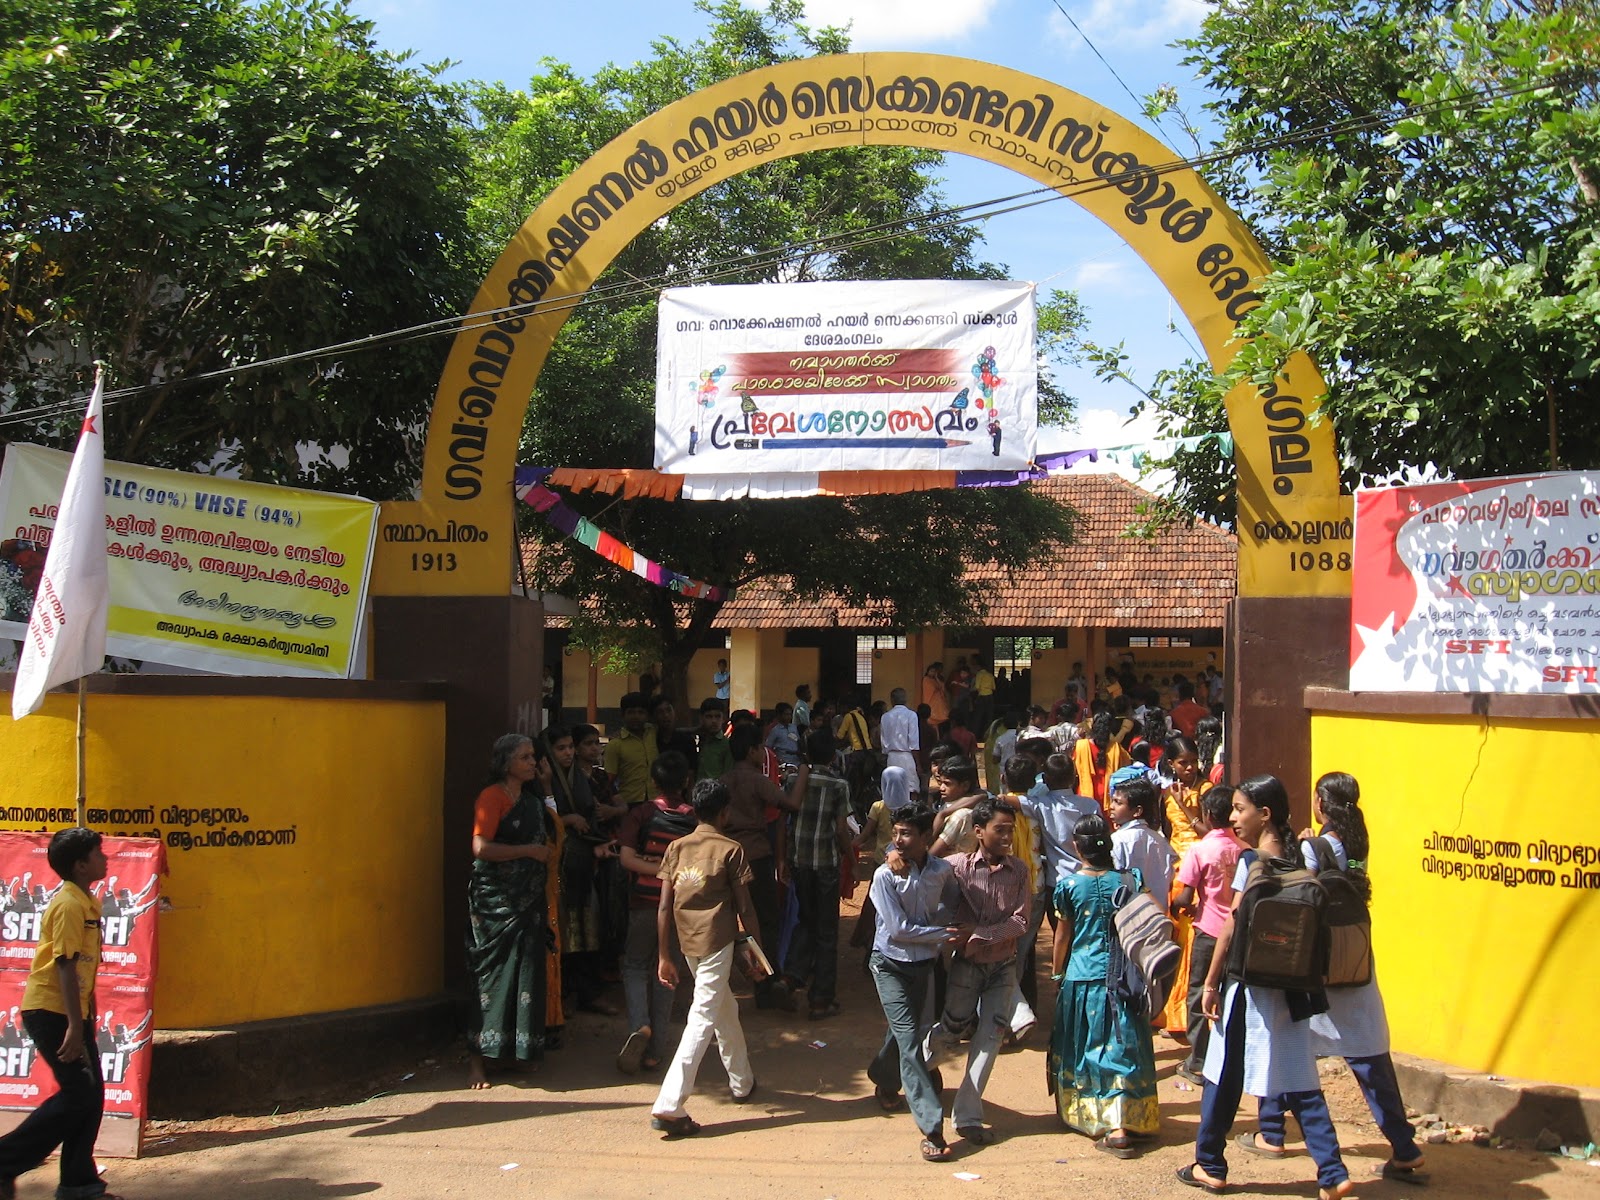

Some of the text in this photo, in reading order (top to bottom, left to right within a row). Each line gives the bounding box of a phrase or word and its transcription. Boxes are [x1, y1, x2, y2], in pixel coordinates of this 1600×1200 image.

[826, 313, 869, 329] ഹയർ
[874, 311, 958, 328] സെക്കണ്ടറി
[962, 310, 1018, 330] സ്കൂൾ
[804, 332, 883, 347] ദേശമംഗലം
[789, 352, 900, 371] നവാഗതർക്ക്
[876, 374, 958, 391] സ്വാഗതം
[712, 405, 979, 450] പ്രവേശനോത്സവം
[194, 491, 247, 519] VHSE
[253, 504, 302, 529] (94%)
[383, 520, 489, 545] സ്ഥാപിതം
[161, 523, 279, 558] ഉന്നതവിജയം
[284, 544, 347, 568] നേടിയ
[411, 552, 458, 572] 1913
[1290, 552, 1351, 572] 1088
[1445, 640, 1511, 655] SFI
[1541, 665, 1599, 683] SFI
[87, 805, 155, 824] അതാണ്
[160, 805, 249, 827] വിദ്യാഭ്യാസം
[1423, 831, 1600, 867] ചിന്തയില്ലാത്ത വിദ്യാഭ്യാ
[2, 912, 41, 941] SFI
